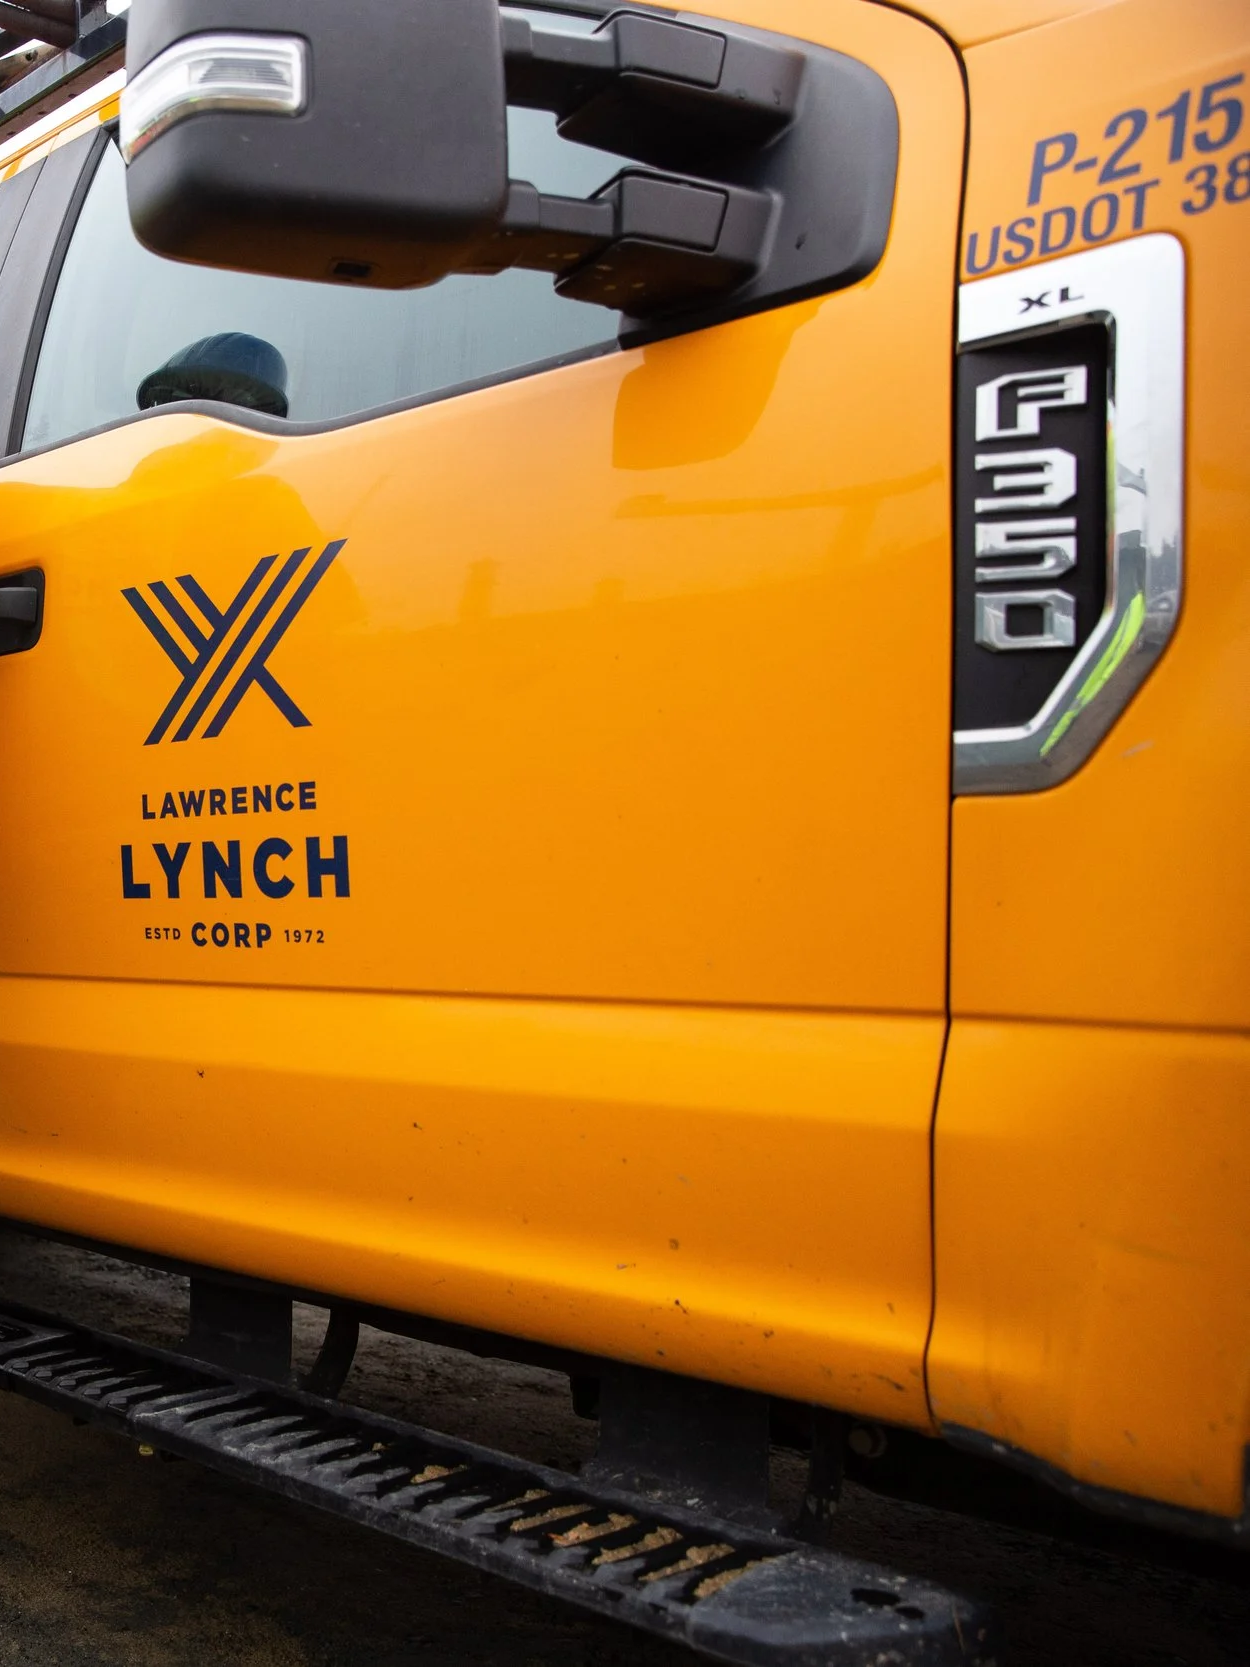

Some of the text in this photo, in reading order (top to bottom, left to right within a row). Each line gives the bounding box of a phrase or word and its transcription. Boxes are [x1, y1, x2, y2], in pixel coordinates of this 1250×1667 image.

[1026, 72, 1246, 208] P-215
[964, 151, 1250, 275] USDOT 38
[1017, 286, 1086, 315] XL
[973, 364, 1088, 653] F350
[141, 781, 317, 820] LAWRENCE
[120, 835, 351, 899] LYNCH
[144, 922, 325, 948] ESTD CORP 1972
